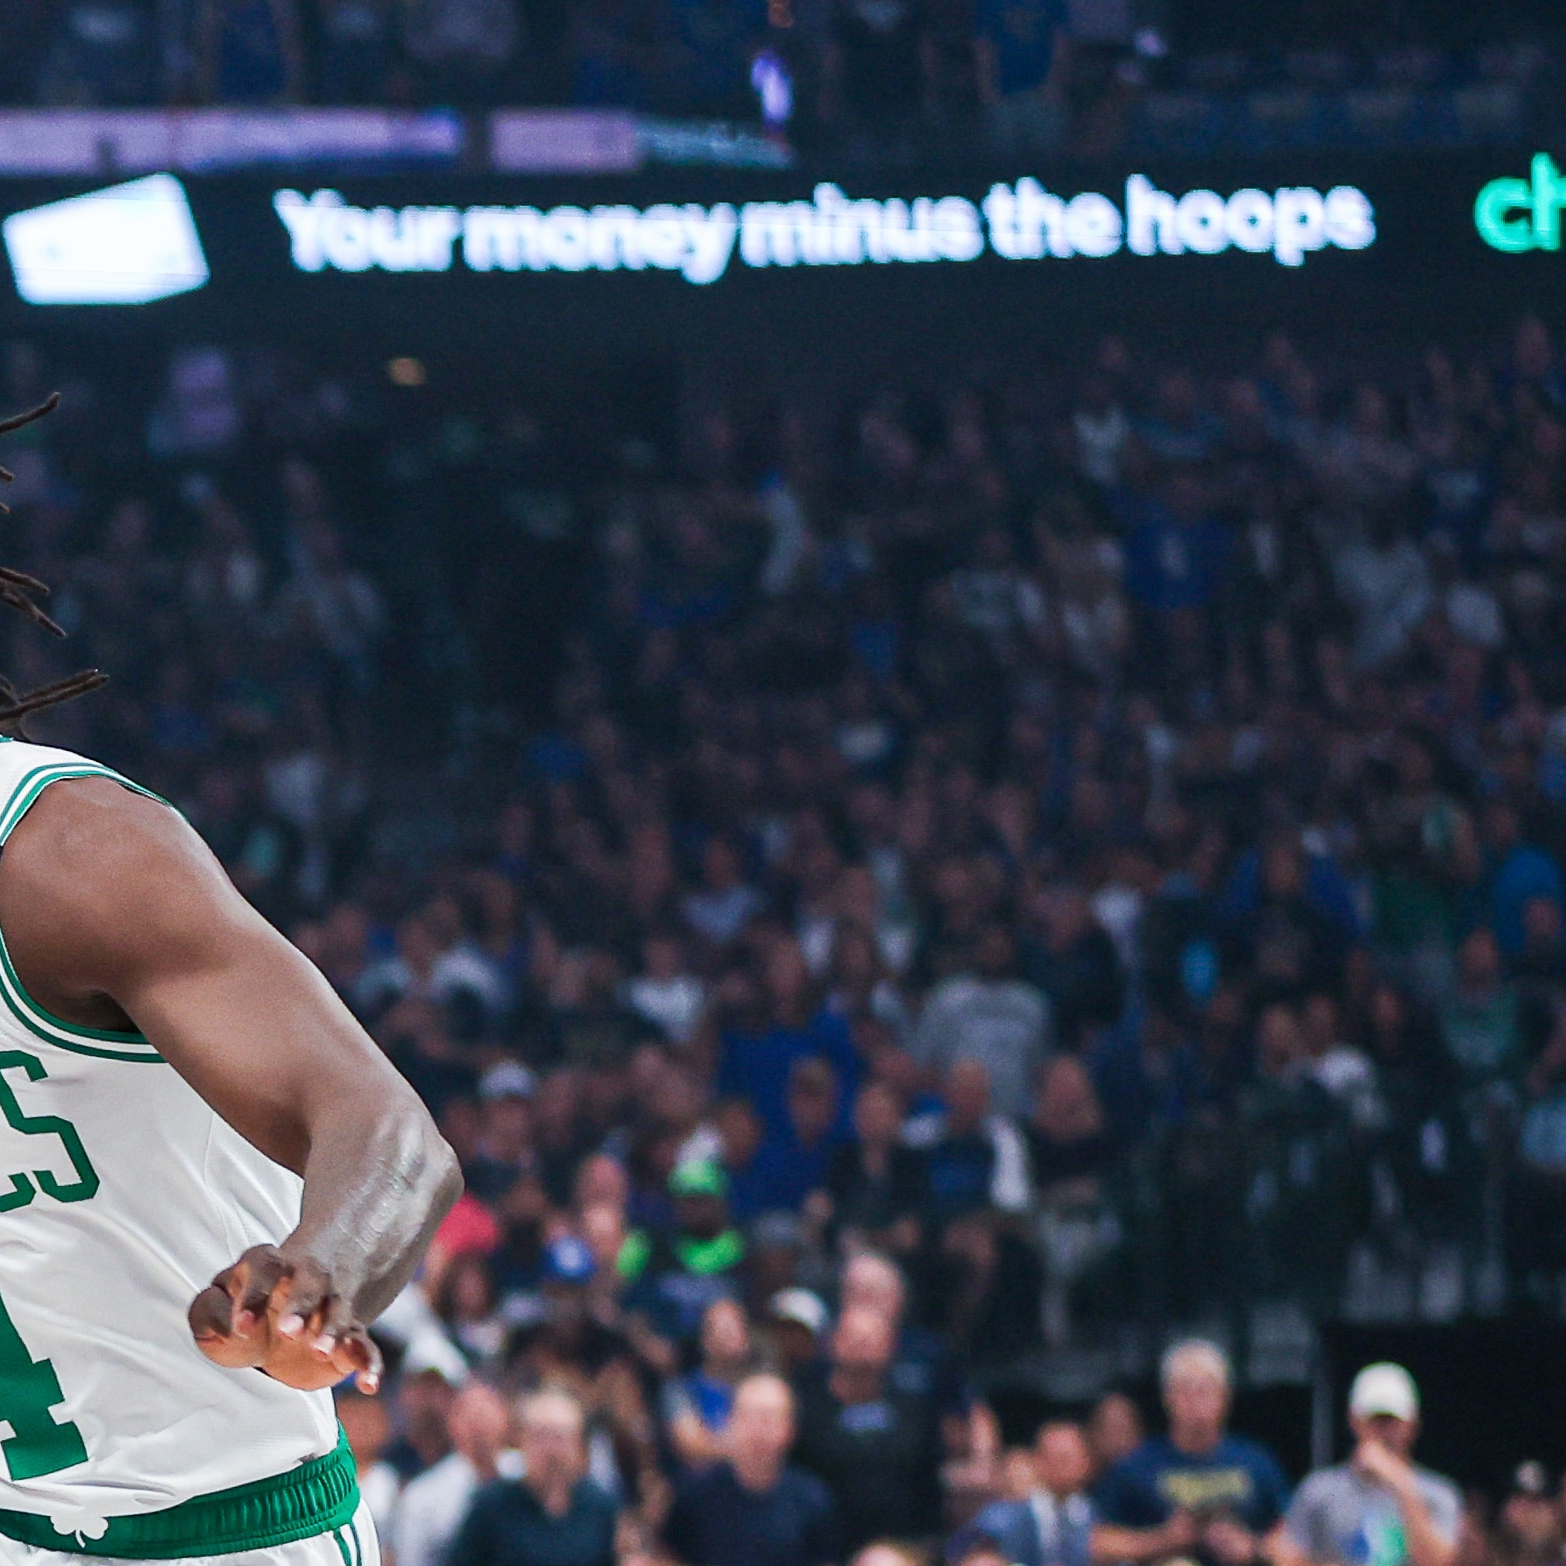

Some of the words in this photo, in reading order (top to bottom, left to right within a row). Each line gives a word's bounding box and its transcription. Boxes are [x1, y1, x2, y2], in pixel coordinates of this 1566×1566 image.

[272, 188, 461, 272] Your
[463, 202, 738, 285] money
[740, 182, 984, 267] minus
[983, 177, 1122, 259] the
[1126, 174, 1377, 267] hoops
